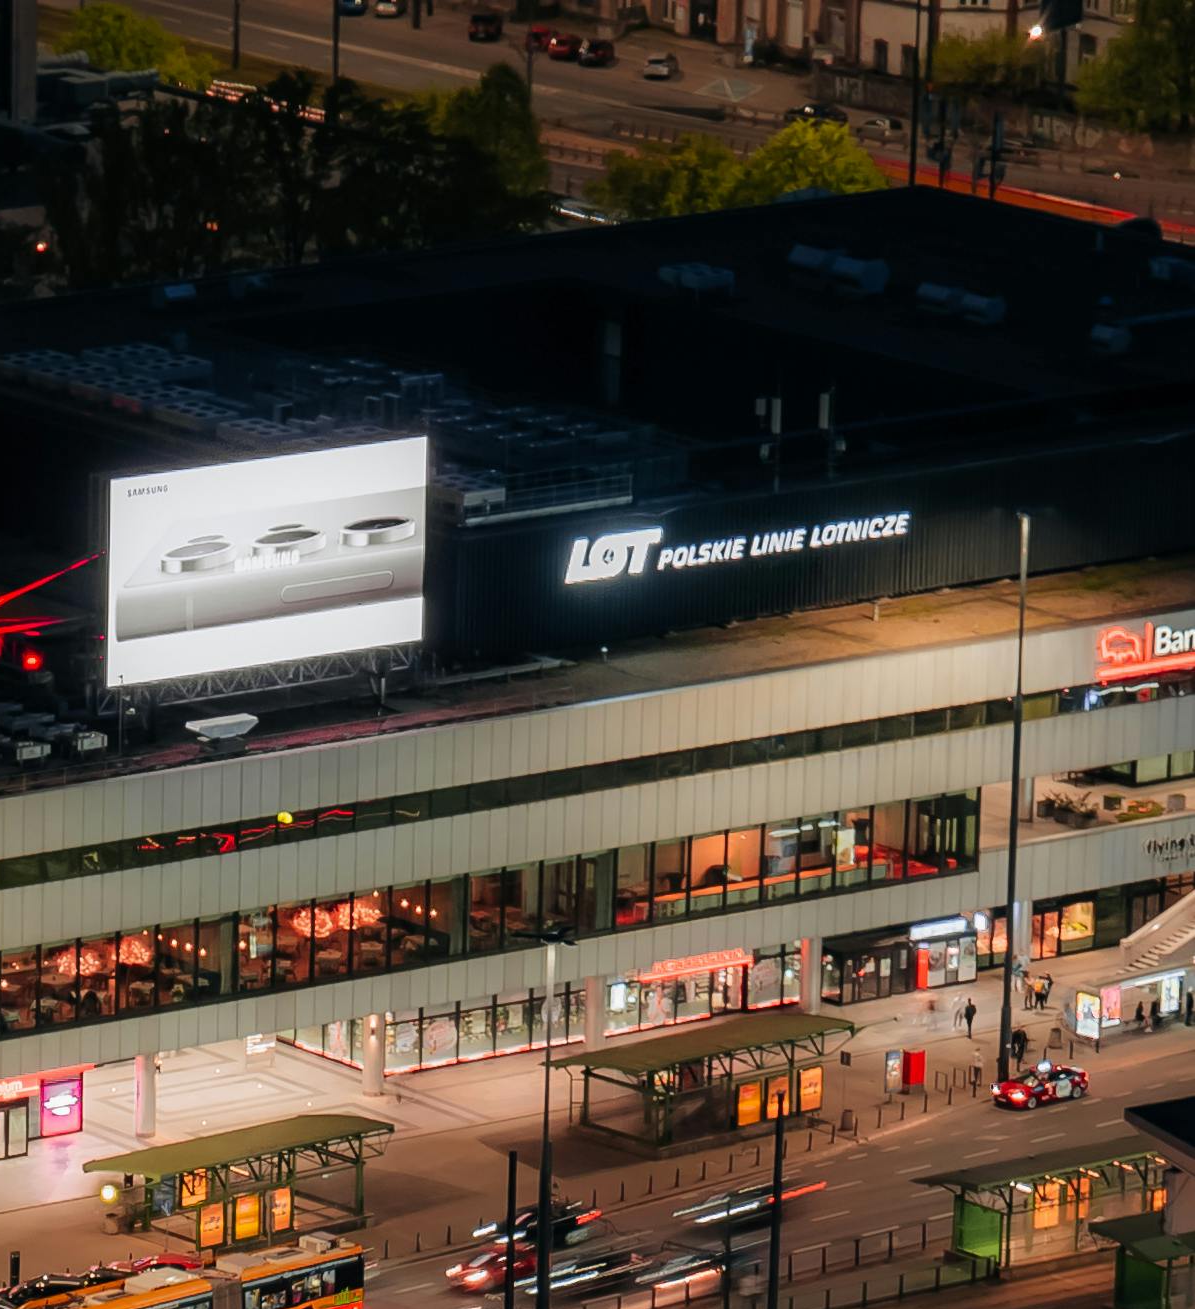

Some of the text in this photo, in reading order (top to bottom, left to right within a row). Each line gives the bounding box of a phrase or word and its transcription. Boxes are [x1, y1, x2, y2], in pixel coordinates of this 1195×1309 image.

[127, 484, 168, 498] SAMSUNG
[564, 512, 910, 585] LOT POLSKIE LINIE LOTNICZE
